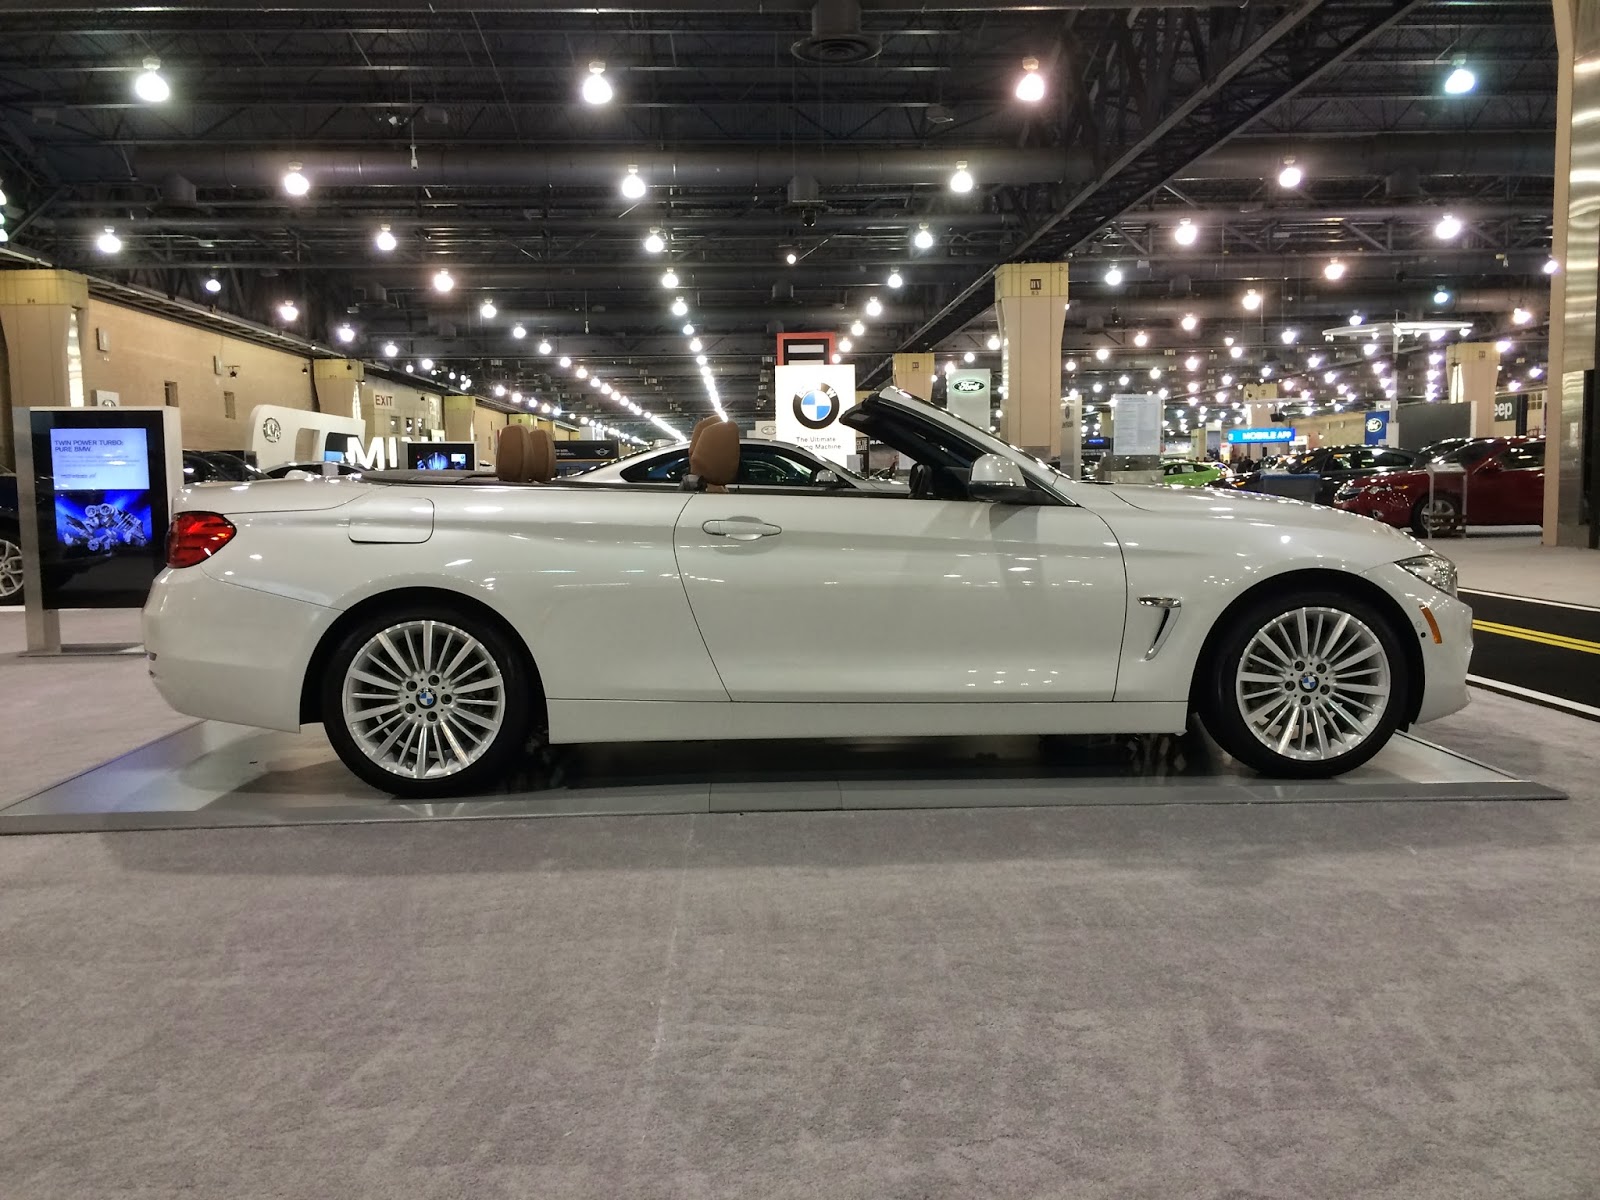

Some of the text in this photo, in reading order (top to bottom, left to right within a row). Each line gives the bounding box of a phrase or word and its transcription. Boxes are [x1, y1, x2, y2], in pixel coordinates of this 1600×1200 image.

[375, 394, 393, 407] EXIT
[1494, 402, 1512, 419] eep
[1242, 431, 1292, 440] MOBILE APP
